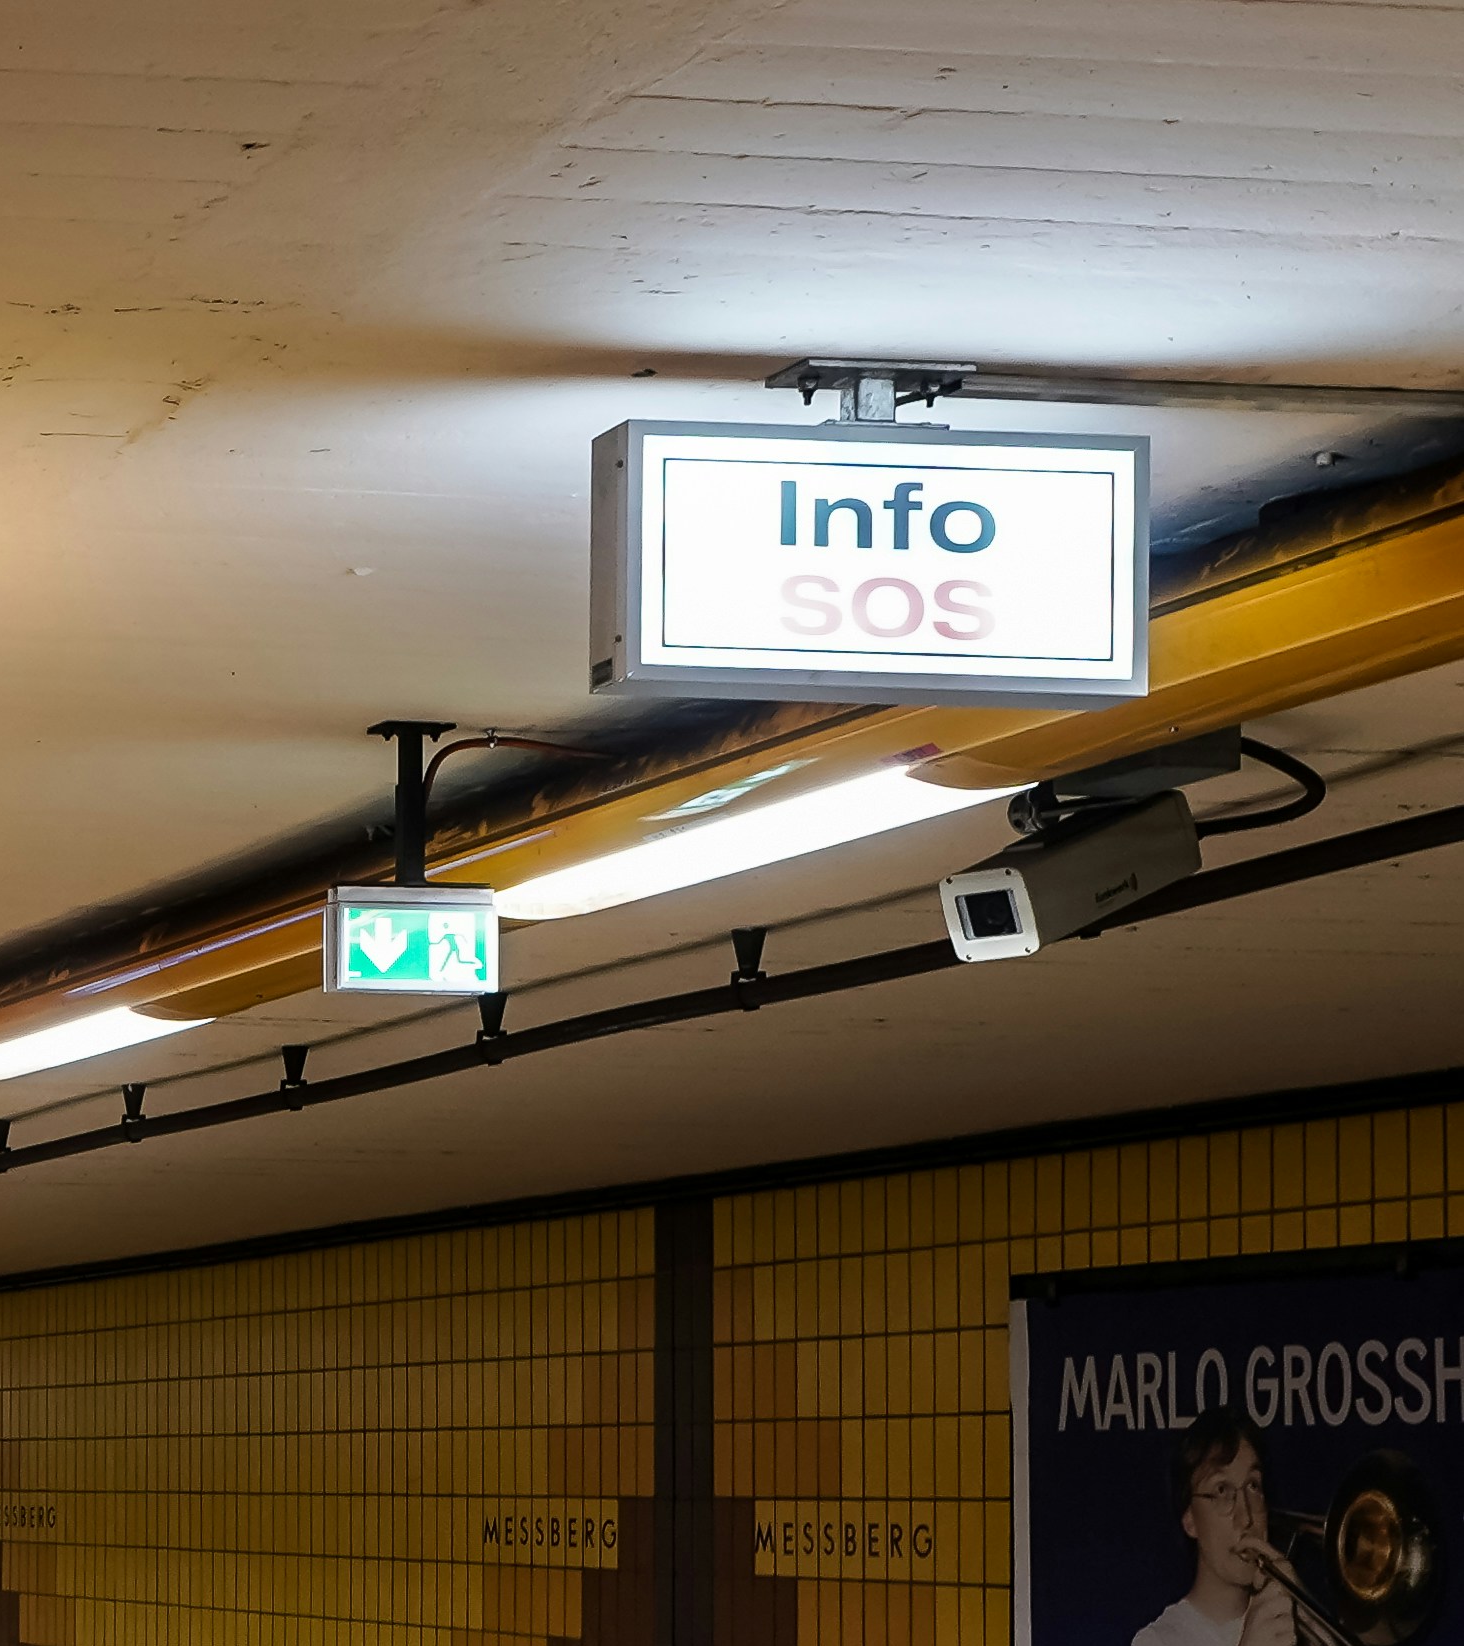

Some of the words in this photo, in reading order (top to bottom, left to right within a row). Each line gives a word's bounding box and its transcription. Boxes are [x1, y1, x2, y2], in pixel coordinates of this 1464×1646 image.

[779, 480, 997, 555] Info
[779, 574, 996, 642] SOS
[1058, 1349, 1229, 1433] MARLO
[1245, 1335, 1464, 1429] GROSSH
[483, 1516, 617, 1550] MESSBERG
[754, 1521, 934, 1560] MESSBERG
